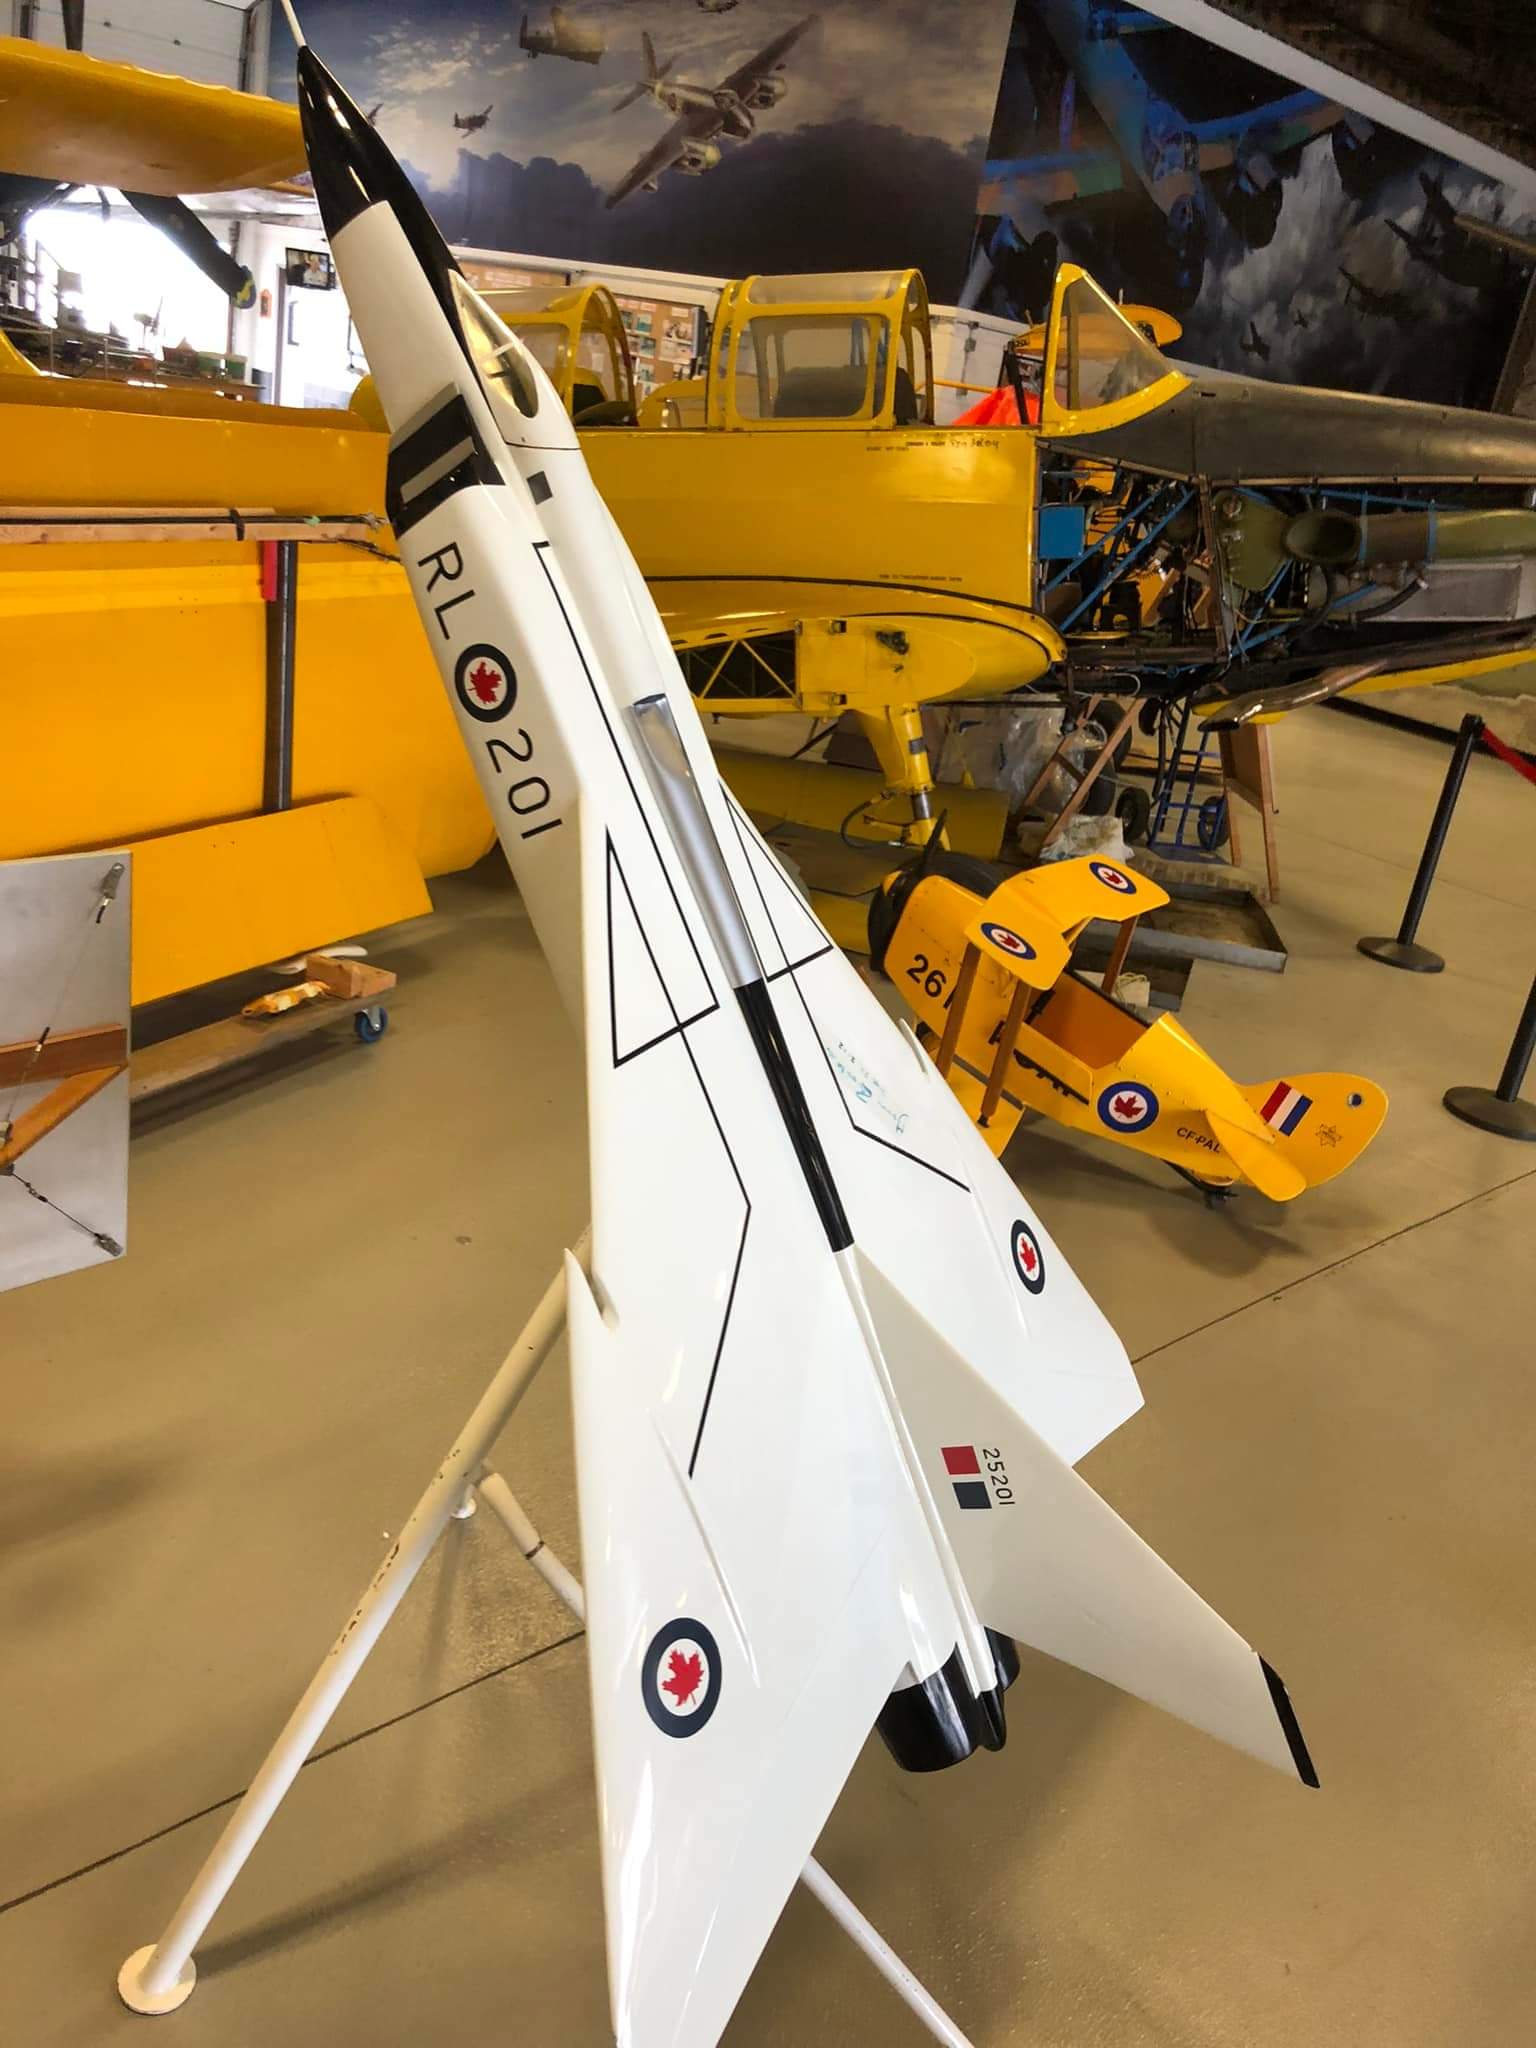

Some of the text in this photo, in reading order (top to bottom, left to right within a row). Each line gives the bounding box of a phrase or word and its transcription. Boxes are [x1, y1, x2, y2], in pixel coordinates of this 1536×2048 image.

[417, 541, 563, 840] RL 201
[982, 1447, 1016, 1506] 25201
